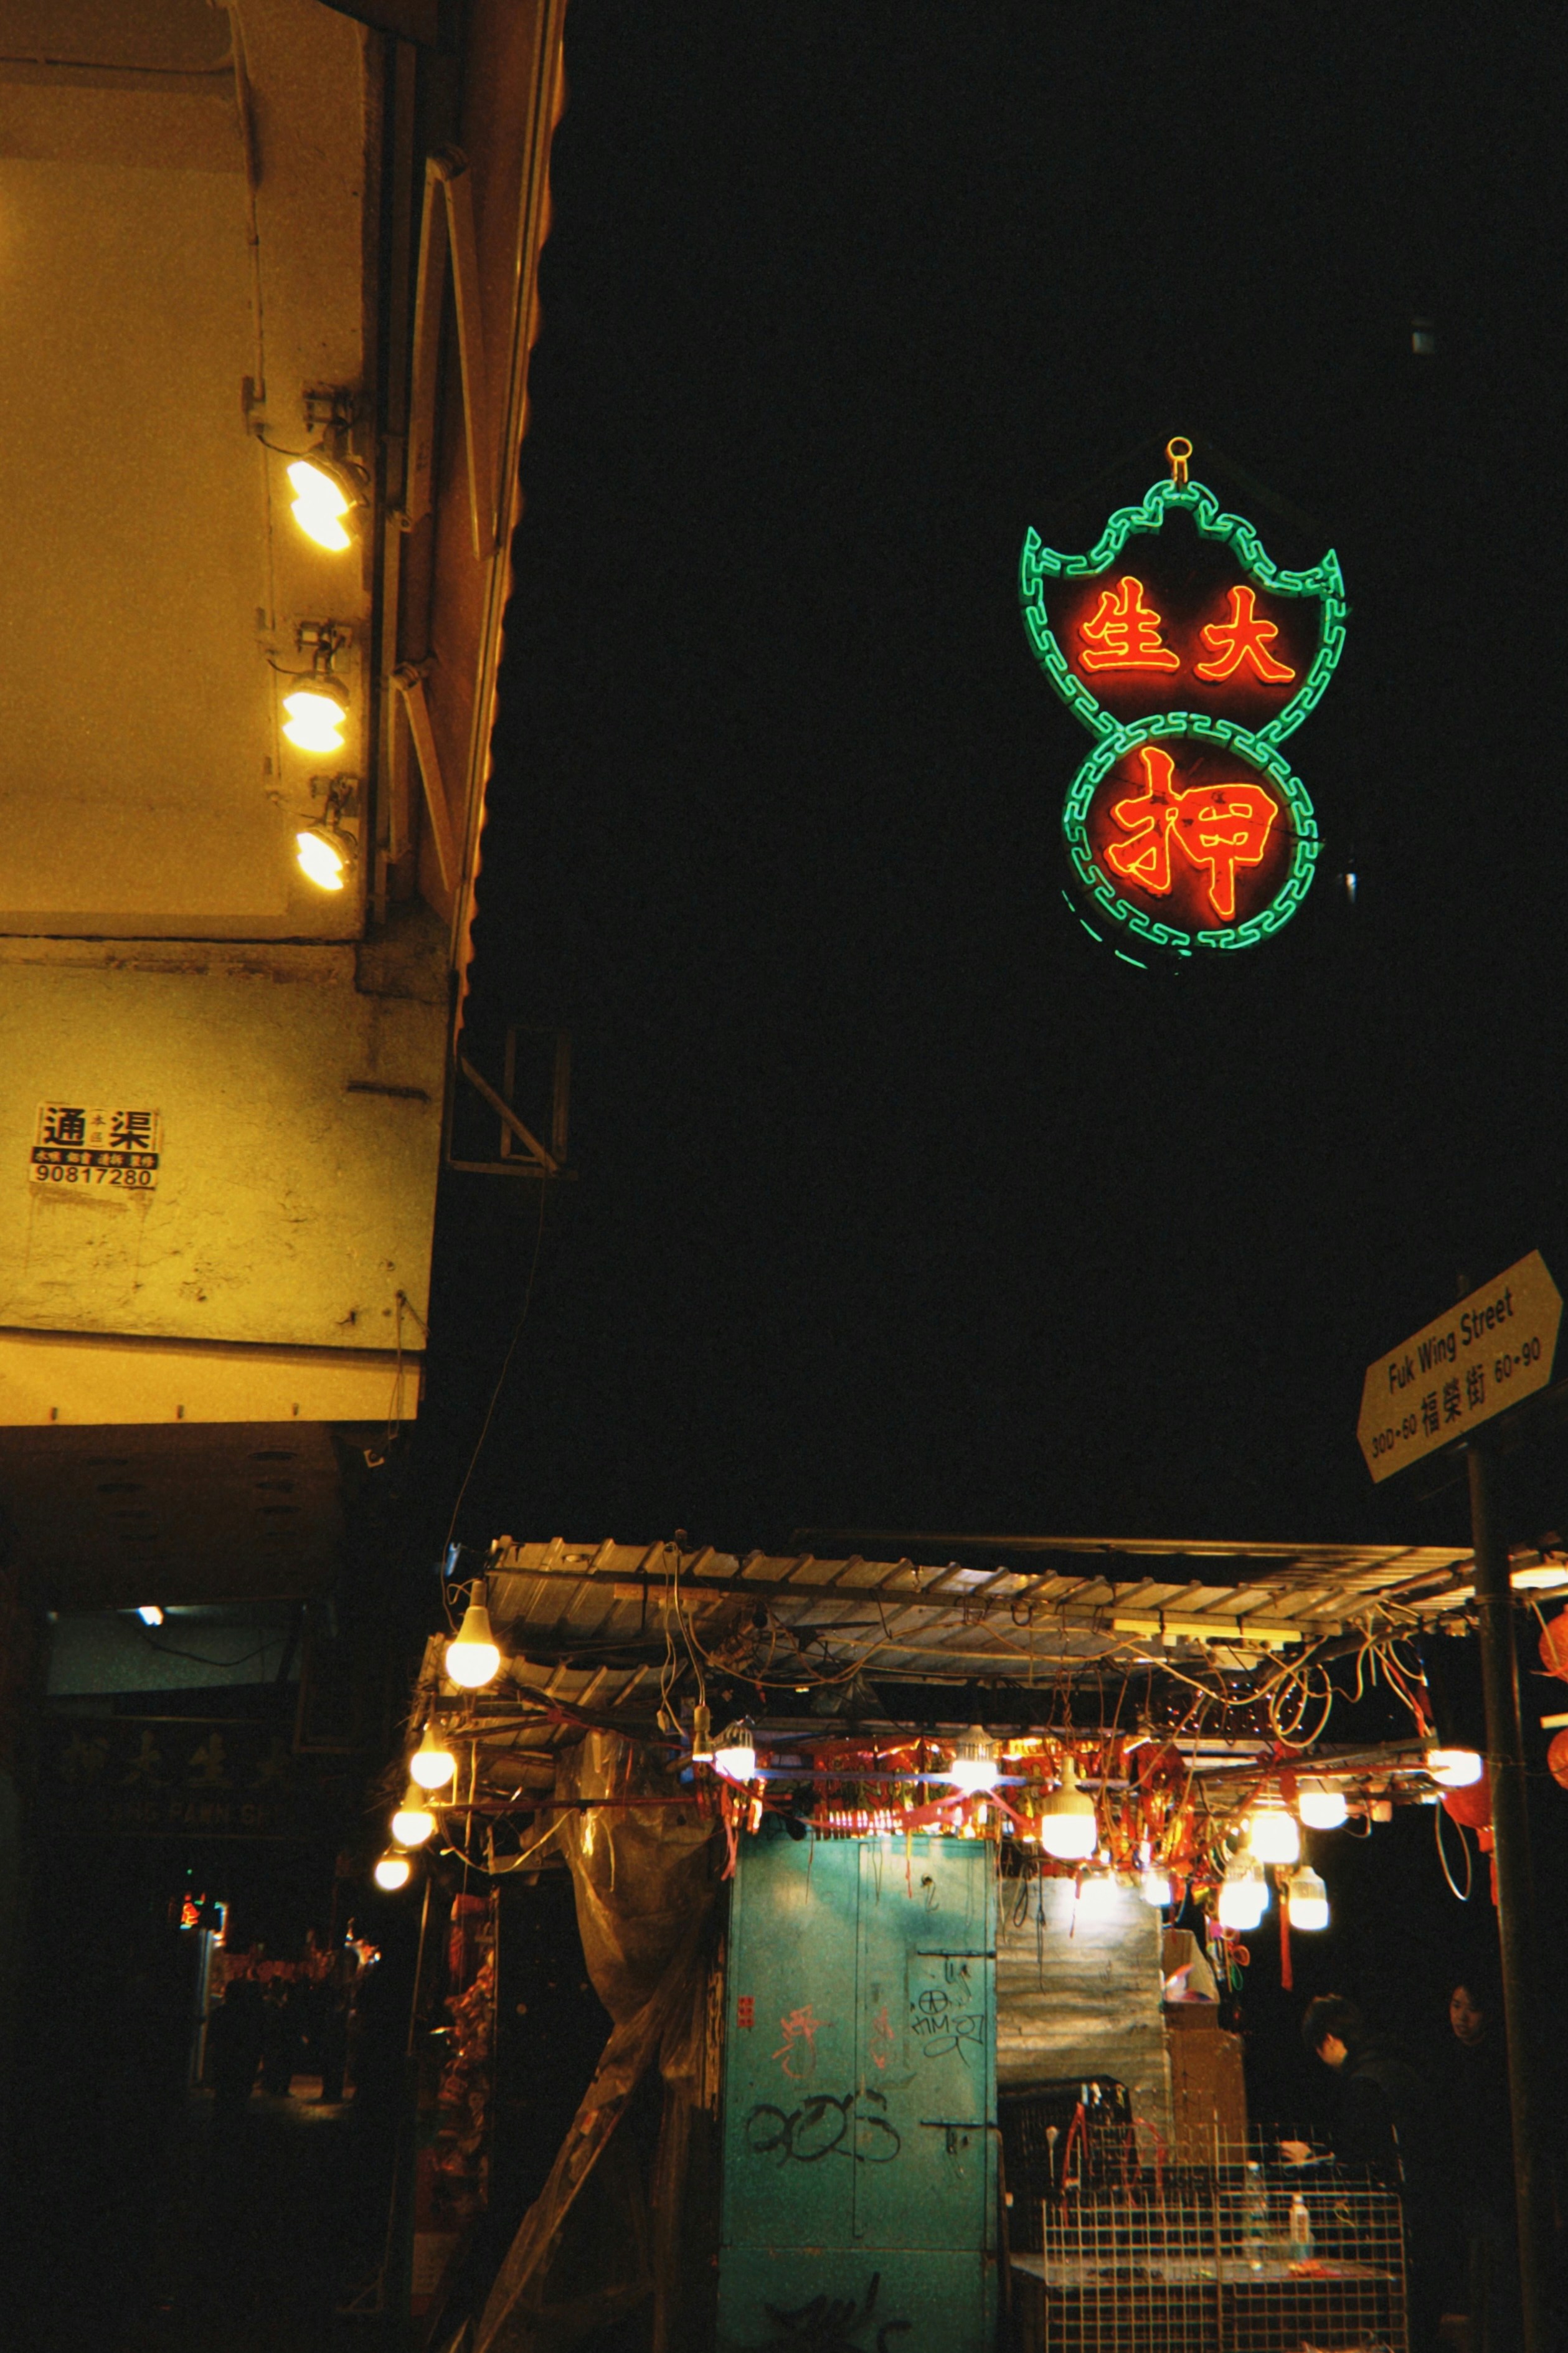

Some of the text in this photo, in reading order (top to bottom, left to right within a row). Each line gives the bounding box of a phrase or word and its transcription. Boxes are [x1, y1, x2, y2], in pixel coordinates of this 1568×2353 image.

[1103, 746, 1278, 923] 押
[35, 1165, 151, 1186] 90817280
[1388, 1286, 1513, 1394] Fuk Wing Street
